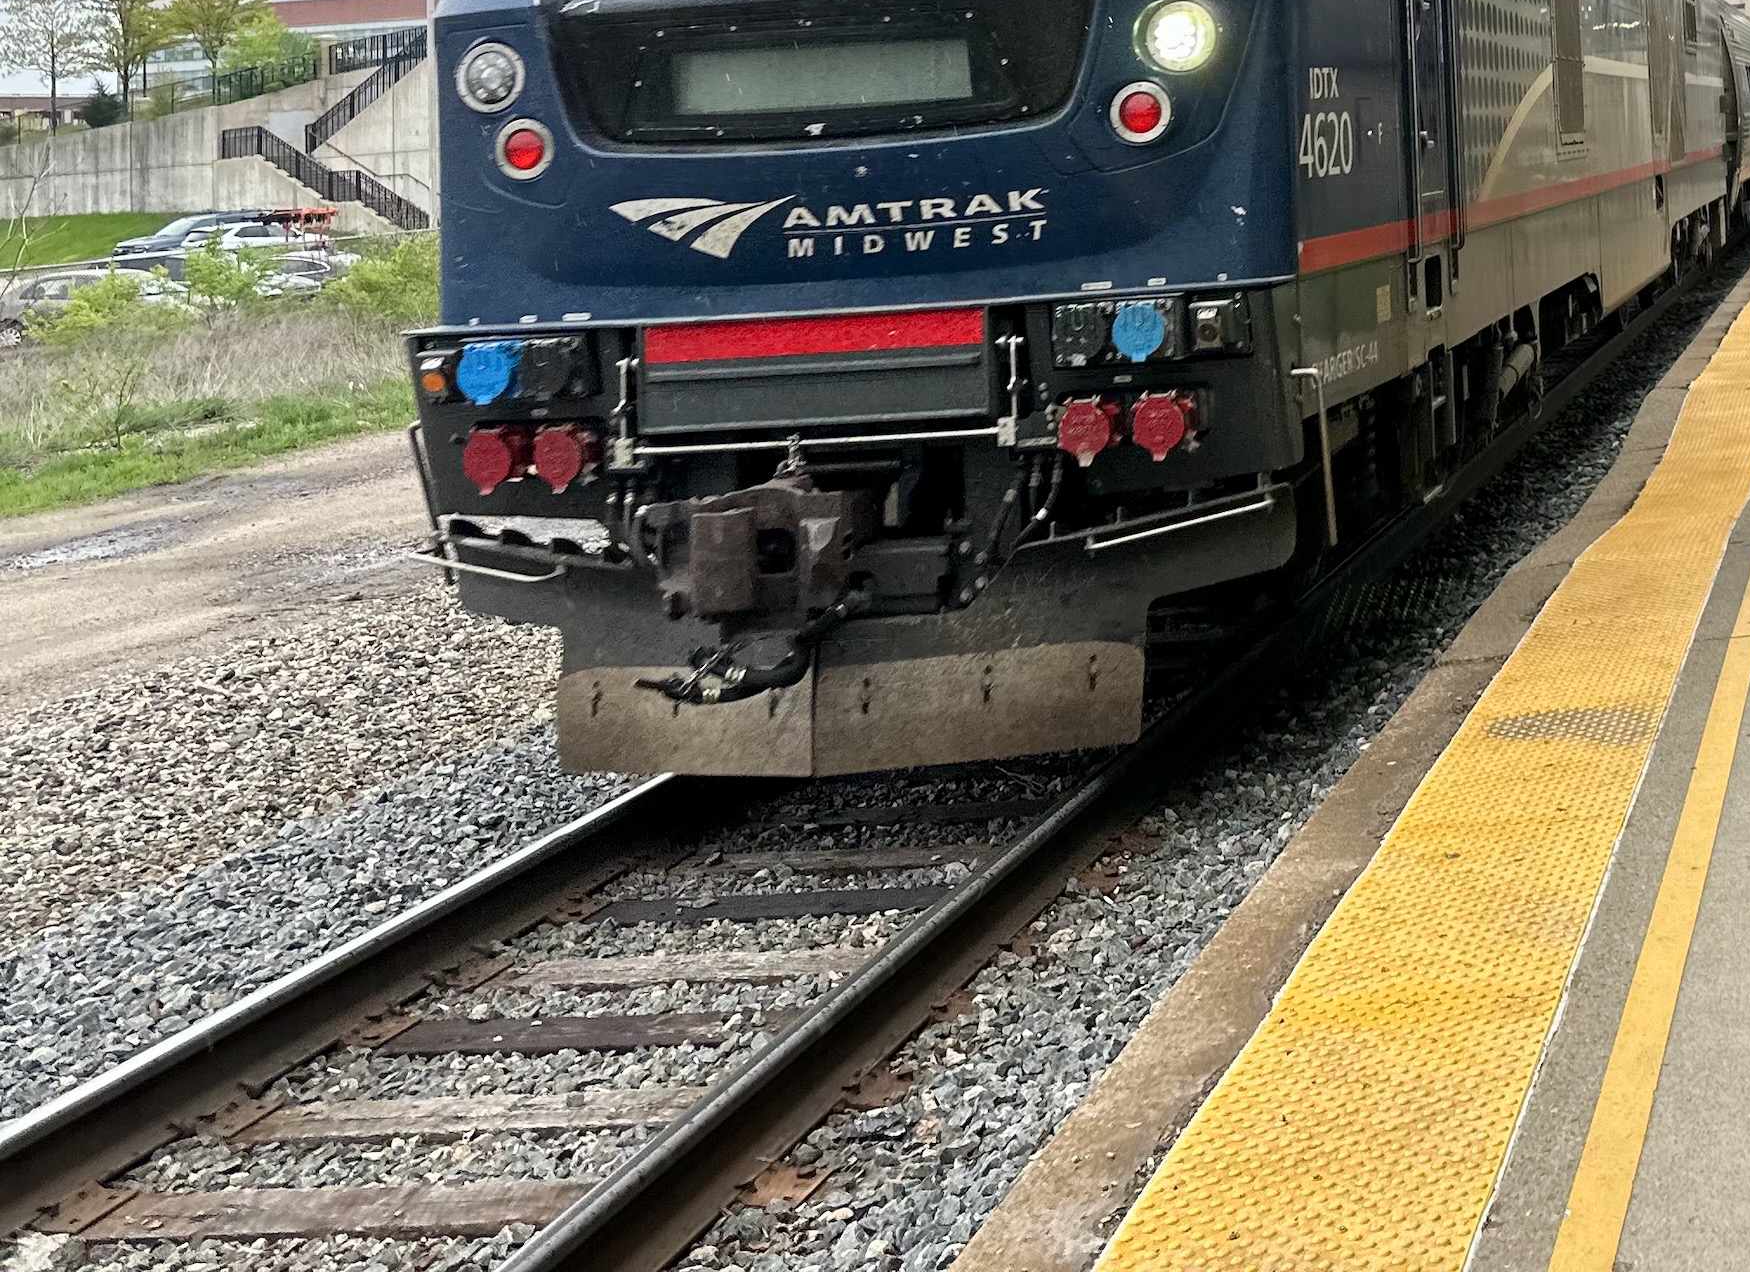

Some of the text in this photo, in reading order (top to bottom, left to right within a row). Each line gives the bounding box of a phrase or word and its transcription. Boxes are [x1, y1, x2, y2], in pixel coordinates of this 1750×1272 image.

[1309, 67, 1339, 100] IDTX
[1299, 110, 1354, 179] 4620
[782, 187, 1047, 229] AMTRAK
[787, 219, 1048, 258] MIDWEST
